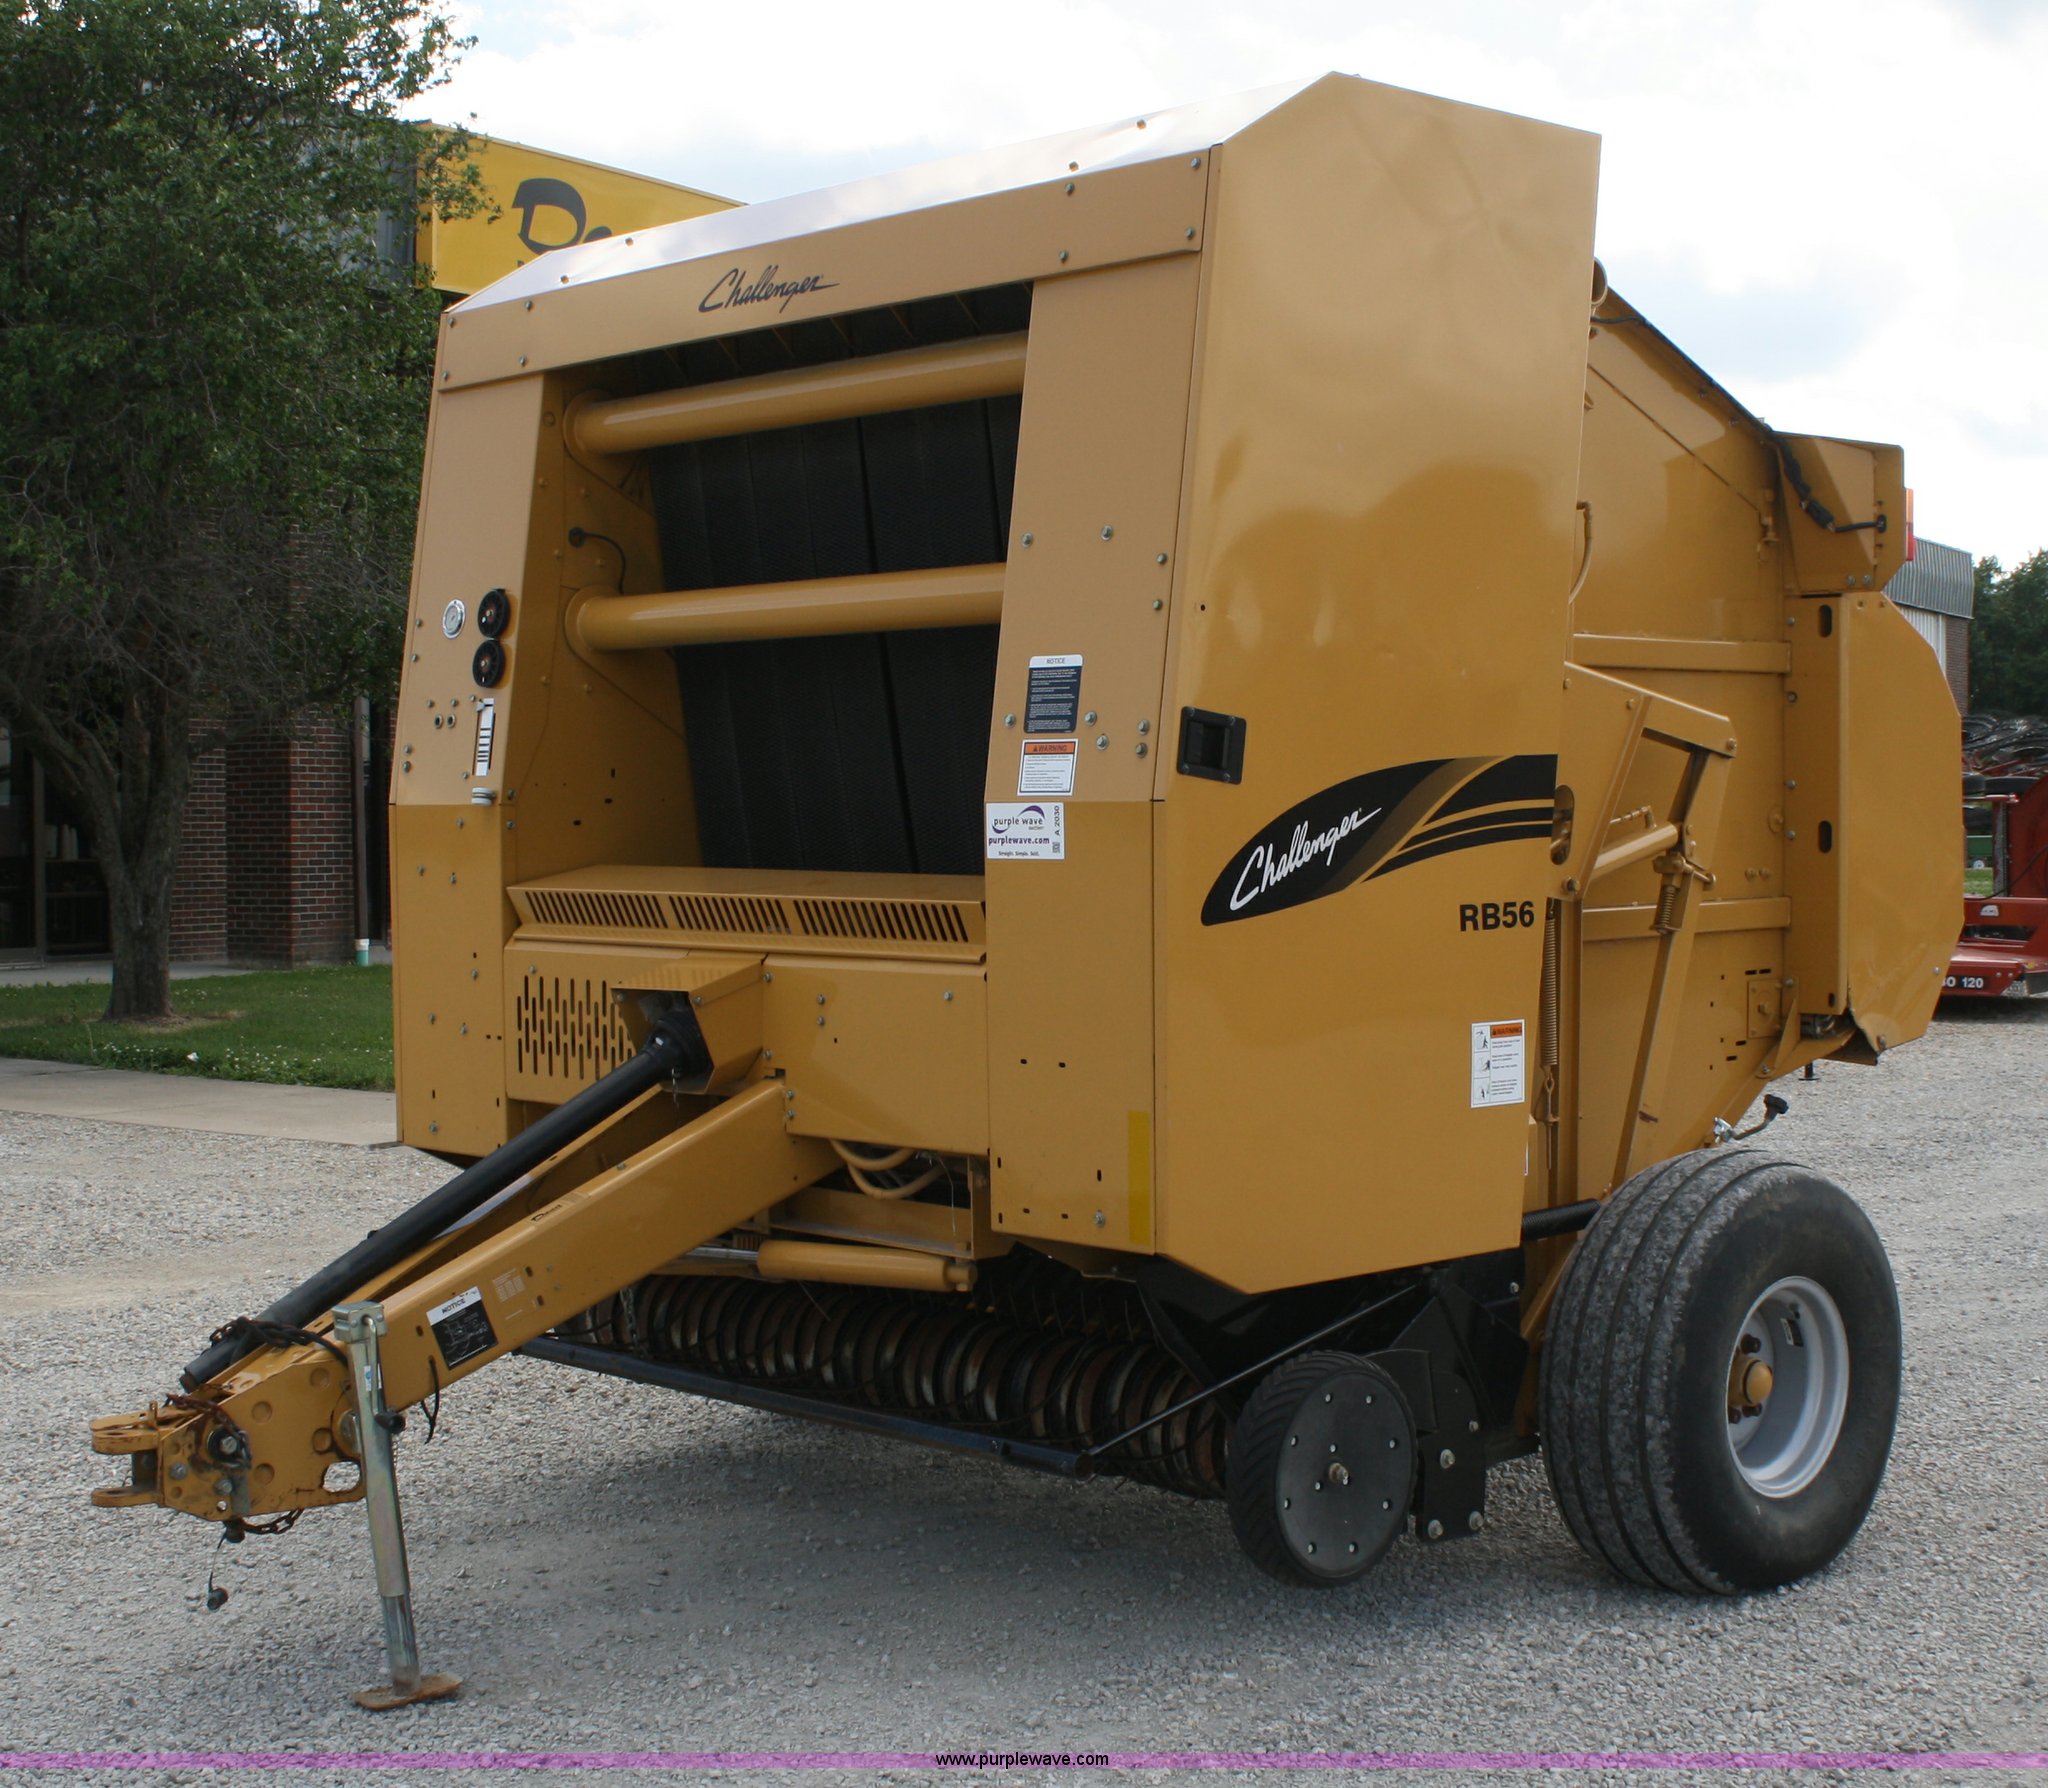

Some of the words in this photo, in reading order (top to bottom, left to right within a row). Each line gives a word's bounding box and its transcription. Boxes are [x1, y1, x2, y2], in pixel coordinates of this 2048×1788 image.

[698, 265, 840, 313] Challenger
[993, 817, 1020, 827] purple
[988, 835, 1050, 847] purplewave.com
[1230, 807, 1382, 911] Challenger
[1459, 900, 1535, 932] RB56
[1962, 976, 1984, 989] 120
[441, 1298, 466, 1314] NOTICE
